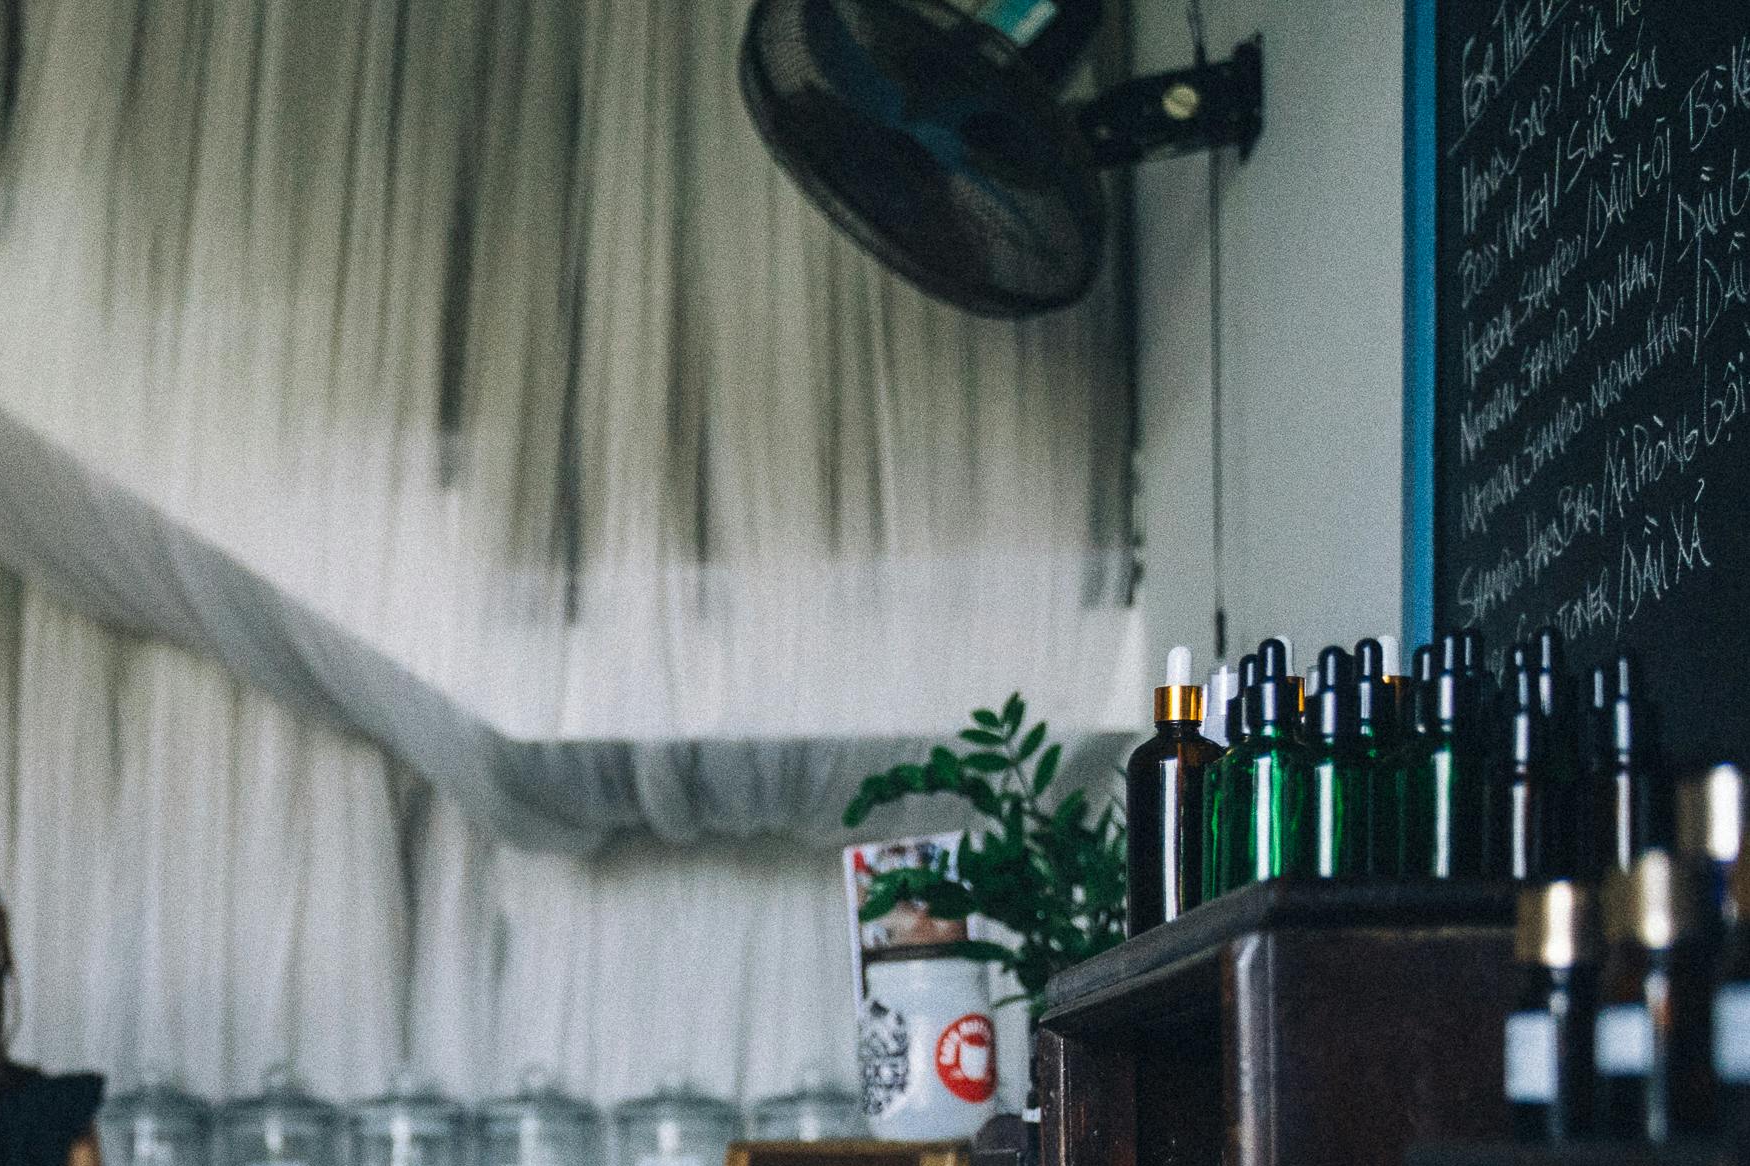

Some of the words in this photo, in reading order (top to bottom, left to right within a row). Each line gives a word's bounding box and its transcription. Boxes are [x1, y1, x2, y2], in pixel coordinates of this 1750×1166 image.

[1461, 147, 1510, 235] HAND
[1507, 85, 1553, 174] SOAP
[1457, 222, 1500, 310] BODY
[1503, 172, 1550, 259] WASH
[1585, 274, 1617, 341] DRY
[1618, 240, 1657, 310] HAIR
[1591, 344, 1648, 418] NORMAL
[1644, 296, 1693, 367] HAIR
[1557, 483, 1601, 547] BAR
